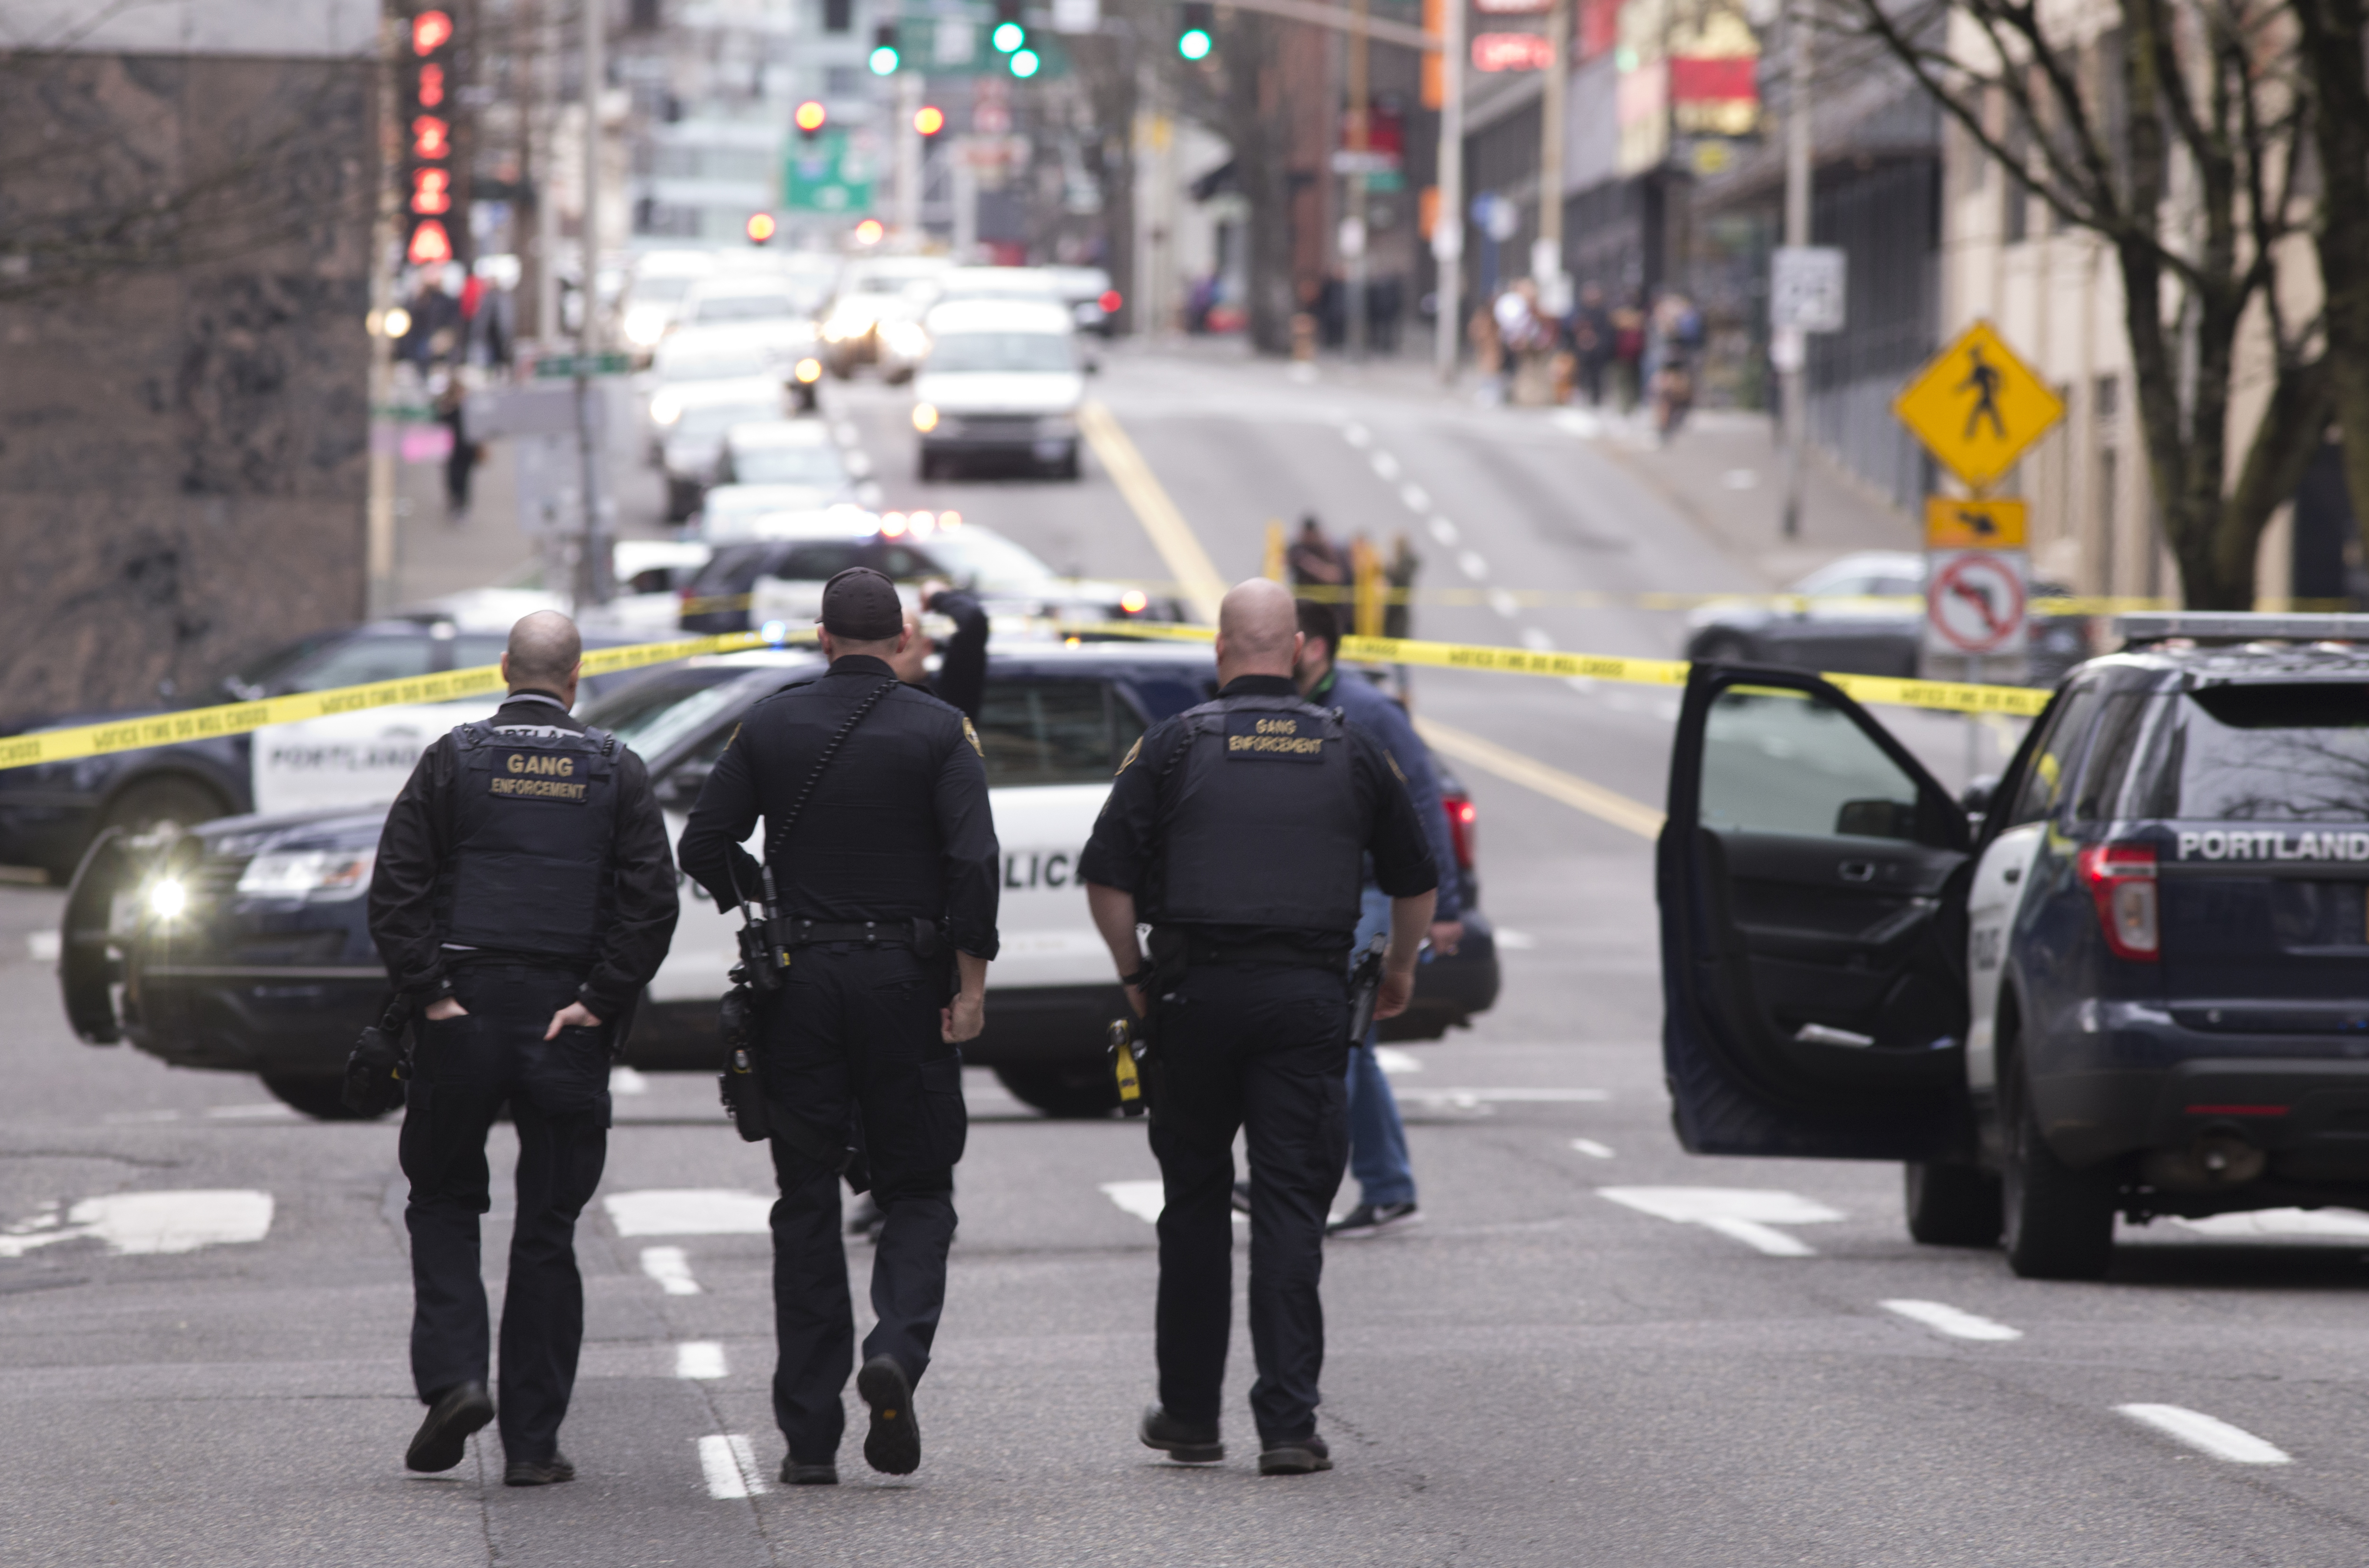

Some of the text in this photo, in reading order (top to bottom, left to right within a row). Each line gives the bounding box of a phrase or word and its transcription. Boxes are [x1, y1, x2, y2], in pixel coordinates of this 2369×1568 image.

[1256, 719, 1297, 735] GANG
[1229, 735, 1324, 754] ENFORCEMENT
[507, 754, 574, 777] GANG
[491, 777, 587, 799] ENFORCEMENT
[2178, 830, 2369, 861] PORTLAND
[1004, 855, 1087, 887] LIC
